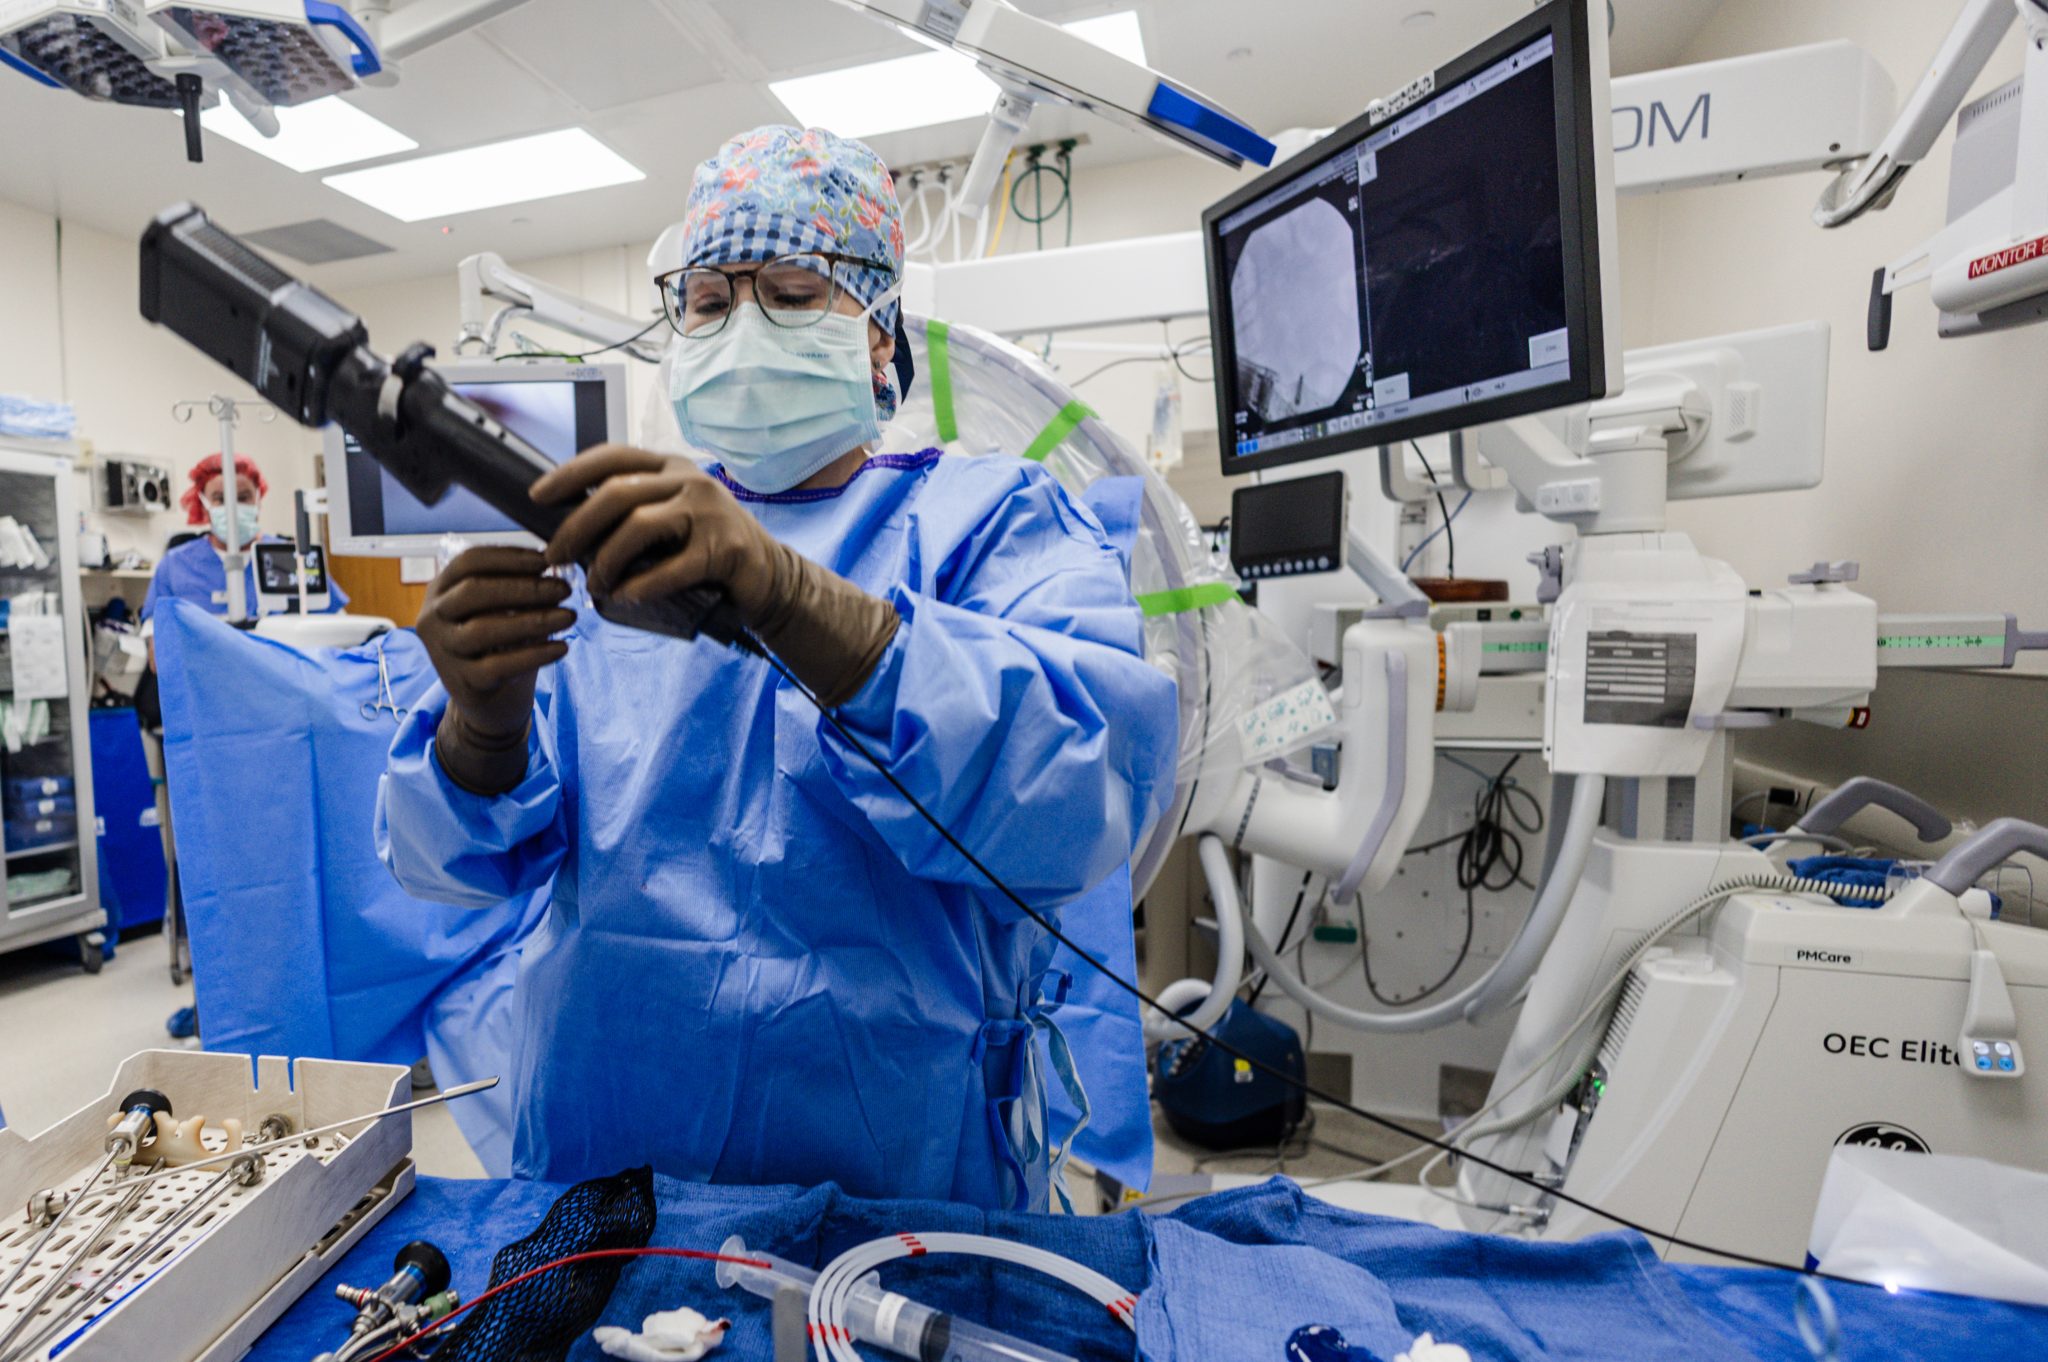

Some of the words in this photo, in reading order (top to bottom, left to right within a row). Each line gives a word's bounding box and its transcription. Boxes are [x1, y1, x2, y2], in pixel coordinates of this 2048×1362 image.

[1972, 241, 2037, 277] MONITOR
[1797, 949, 1851, 964] PMCare
[1823, 1032, 1889, 1059] OEC
